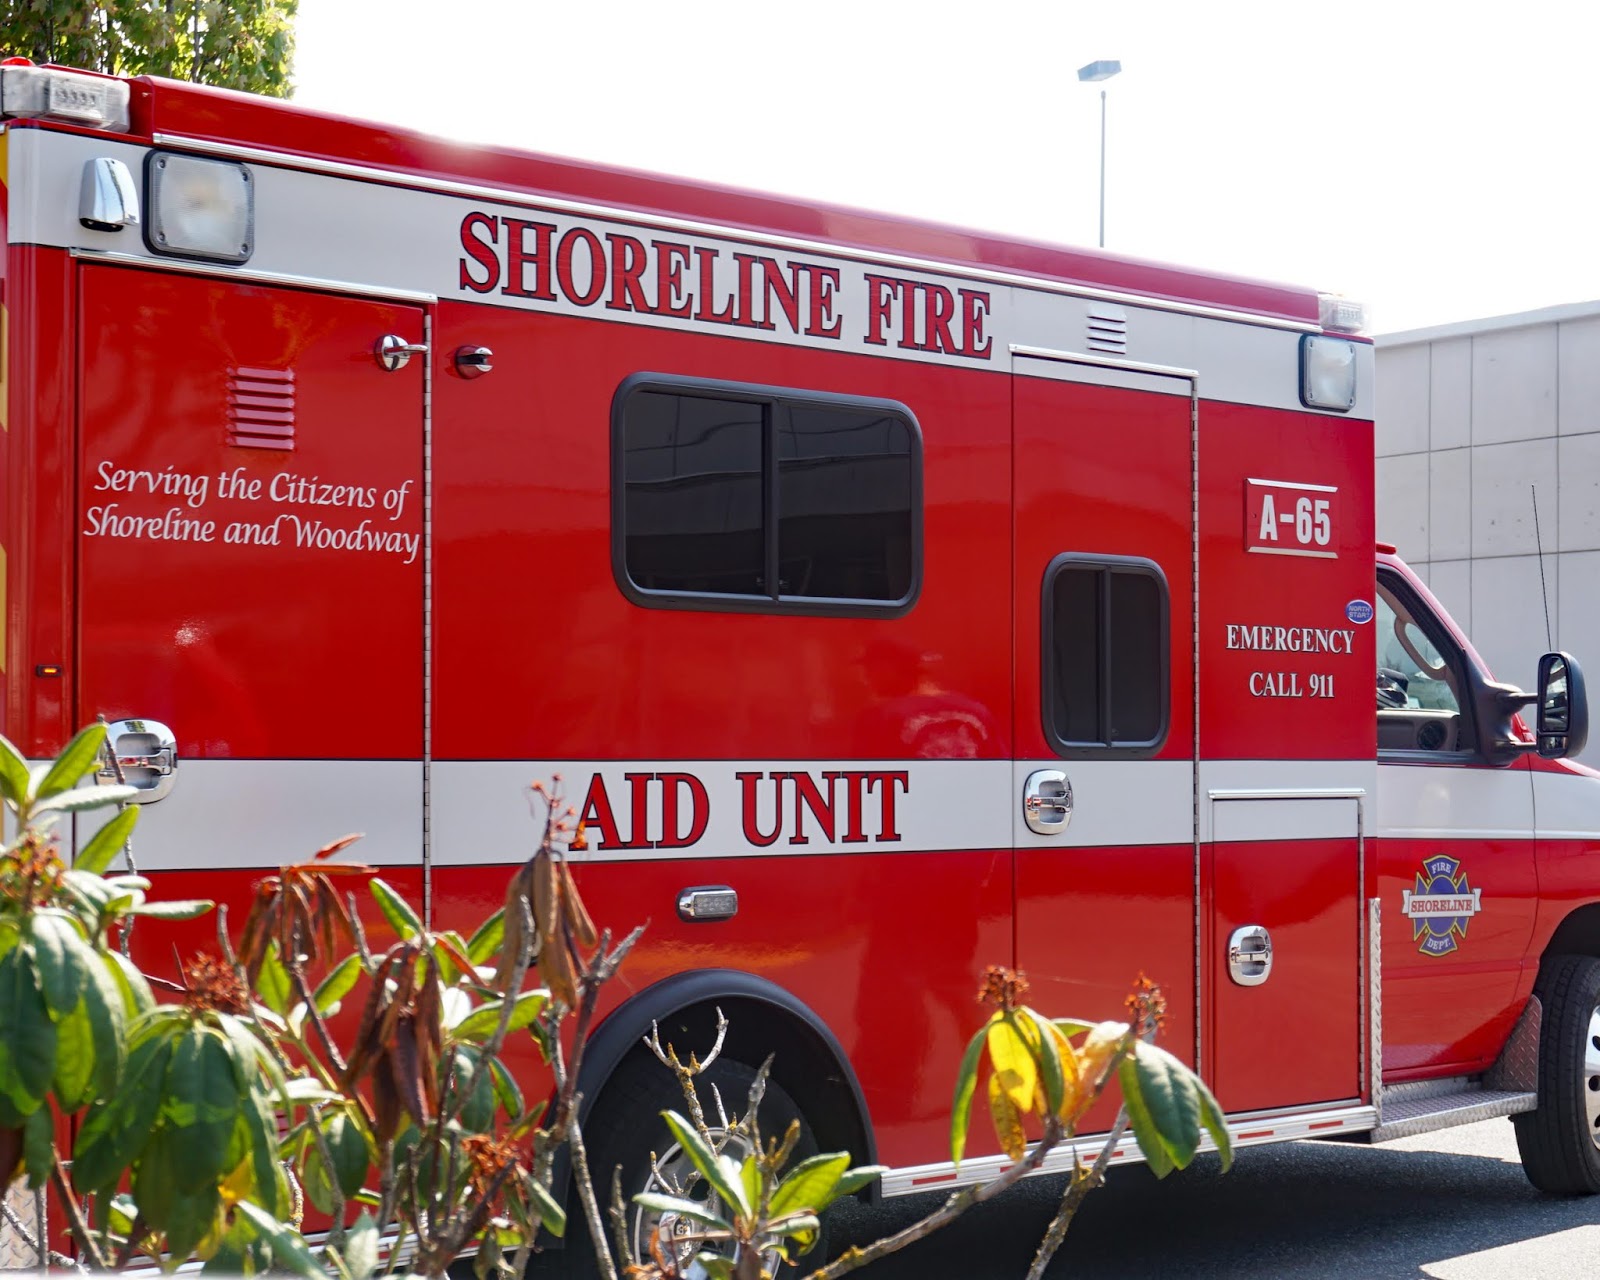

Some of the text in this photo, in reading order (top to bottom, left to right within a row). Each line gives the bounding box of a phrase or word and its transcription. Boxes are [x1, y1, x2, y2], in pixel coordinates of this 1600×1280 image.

[460, 211, 993, 360] SHORELINE FIRE
[94, 461, 414, 520] Serving the Citizens of
[83, 504, 420, 564] Shoreline and Woodway
[1259, 494, 1331, 546] A-65
[1226, 624, 1355, 654] EMERGENCY
[1249, 672, 1335, 698] CALL 911
[568, 771, 909, 851] AID UNIT
[1431, 862, 1451, 874] FIRE
[1411, 899, 1473, 913] SHORELINE
[1427, 938, 1451, 950] DEPT.
